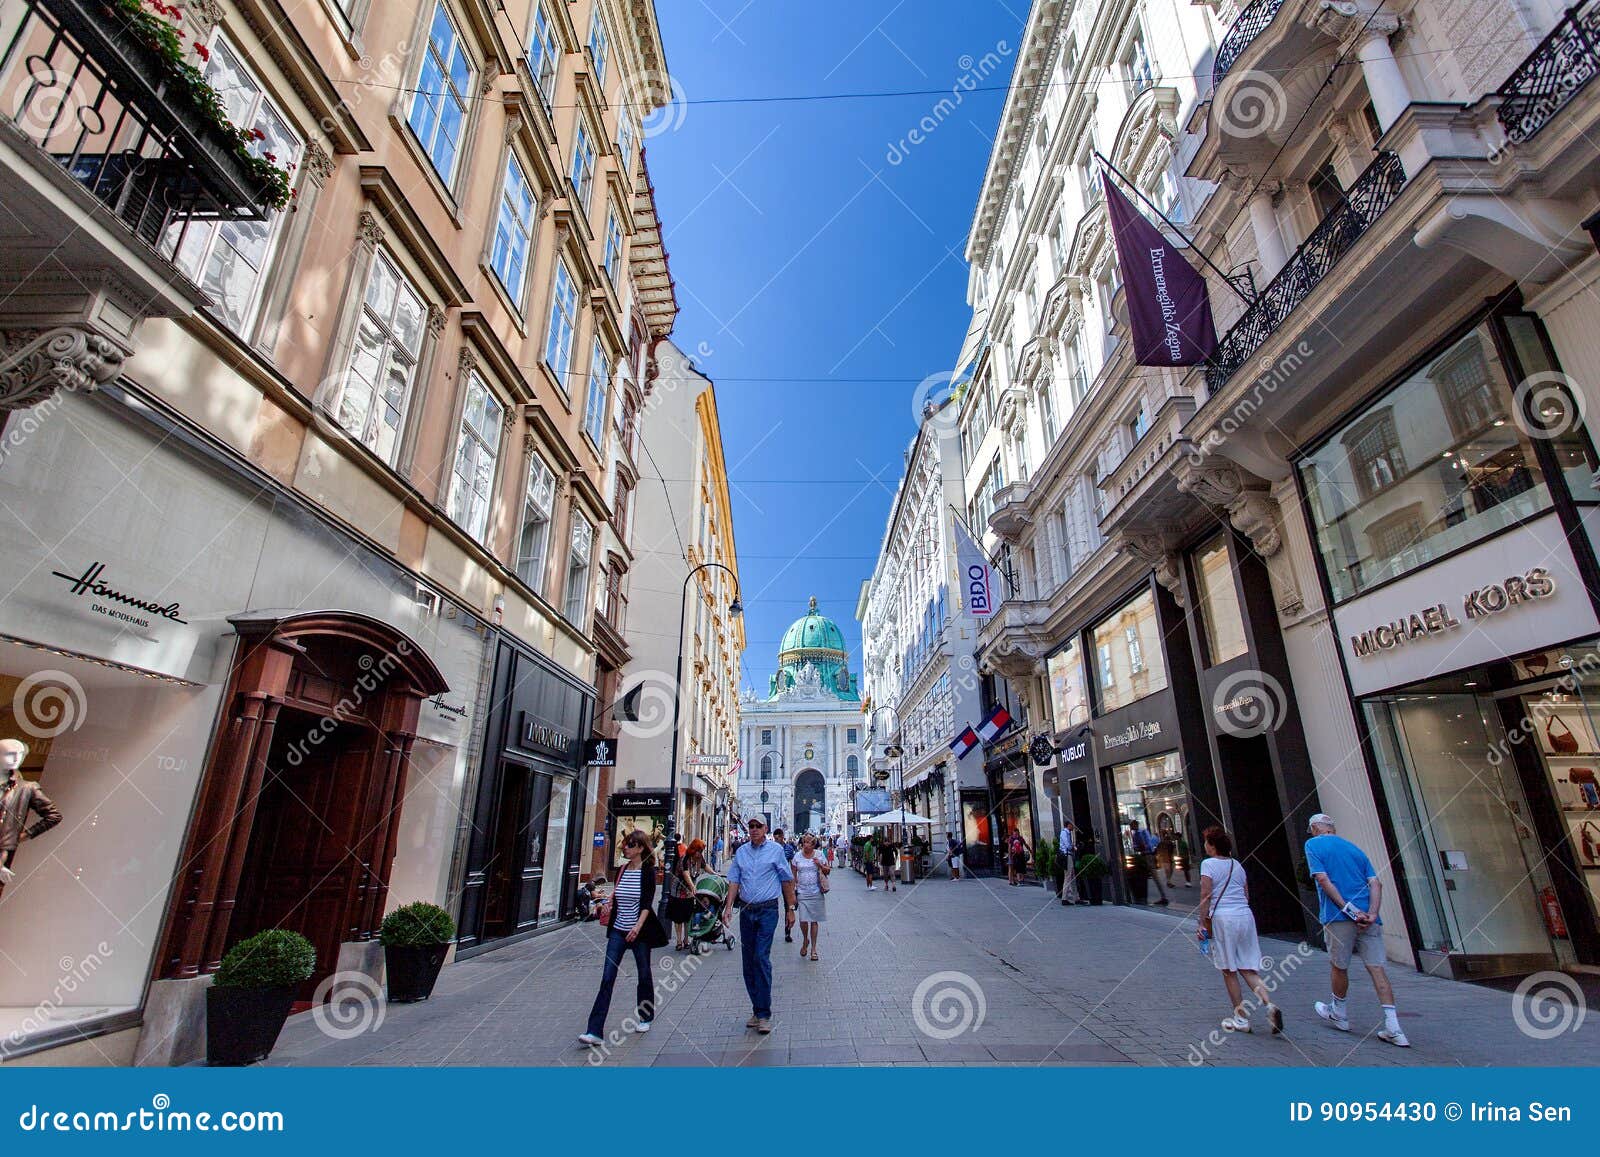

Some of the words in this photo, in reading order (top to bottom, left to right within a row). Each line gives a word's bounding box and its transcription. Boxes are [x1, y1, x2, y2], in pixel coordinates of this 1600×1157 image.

[1149, 246, 1177, 322] Ermenegildo
[1164, 323, 1183, 361] Zegna
[968, 564, 988, 609] BDO
[91, 603, 107, 614] DAS
[108, 609, 149, 627] MODEHAUS
[1351, 603, 1460, 658] MICHAEL
[1464, 567, 1556, 620] KORS
[1061, 743, 1086, 763] HUBLOT
